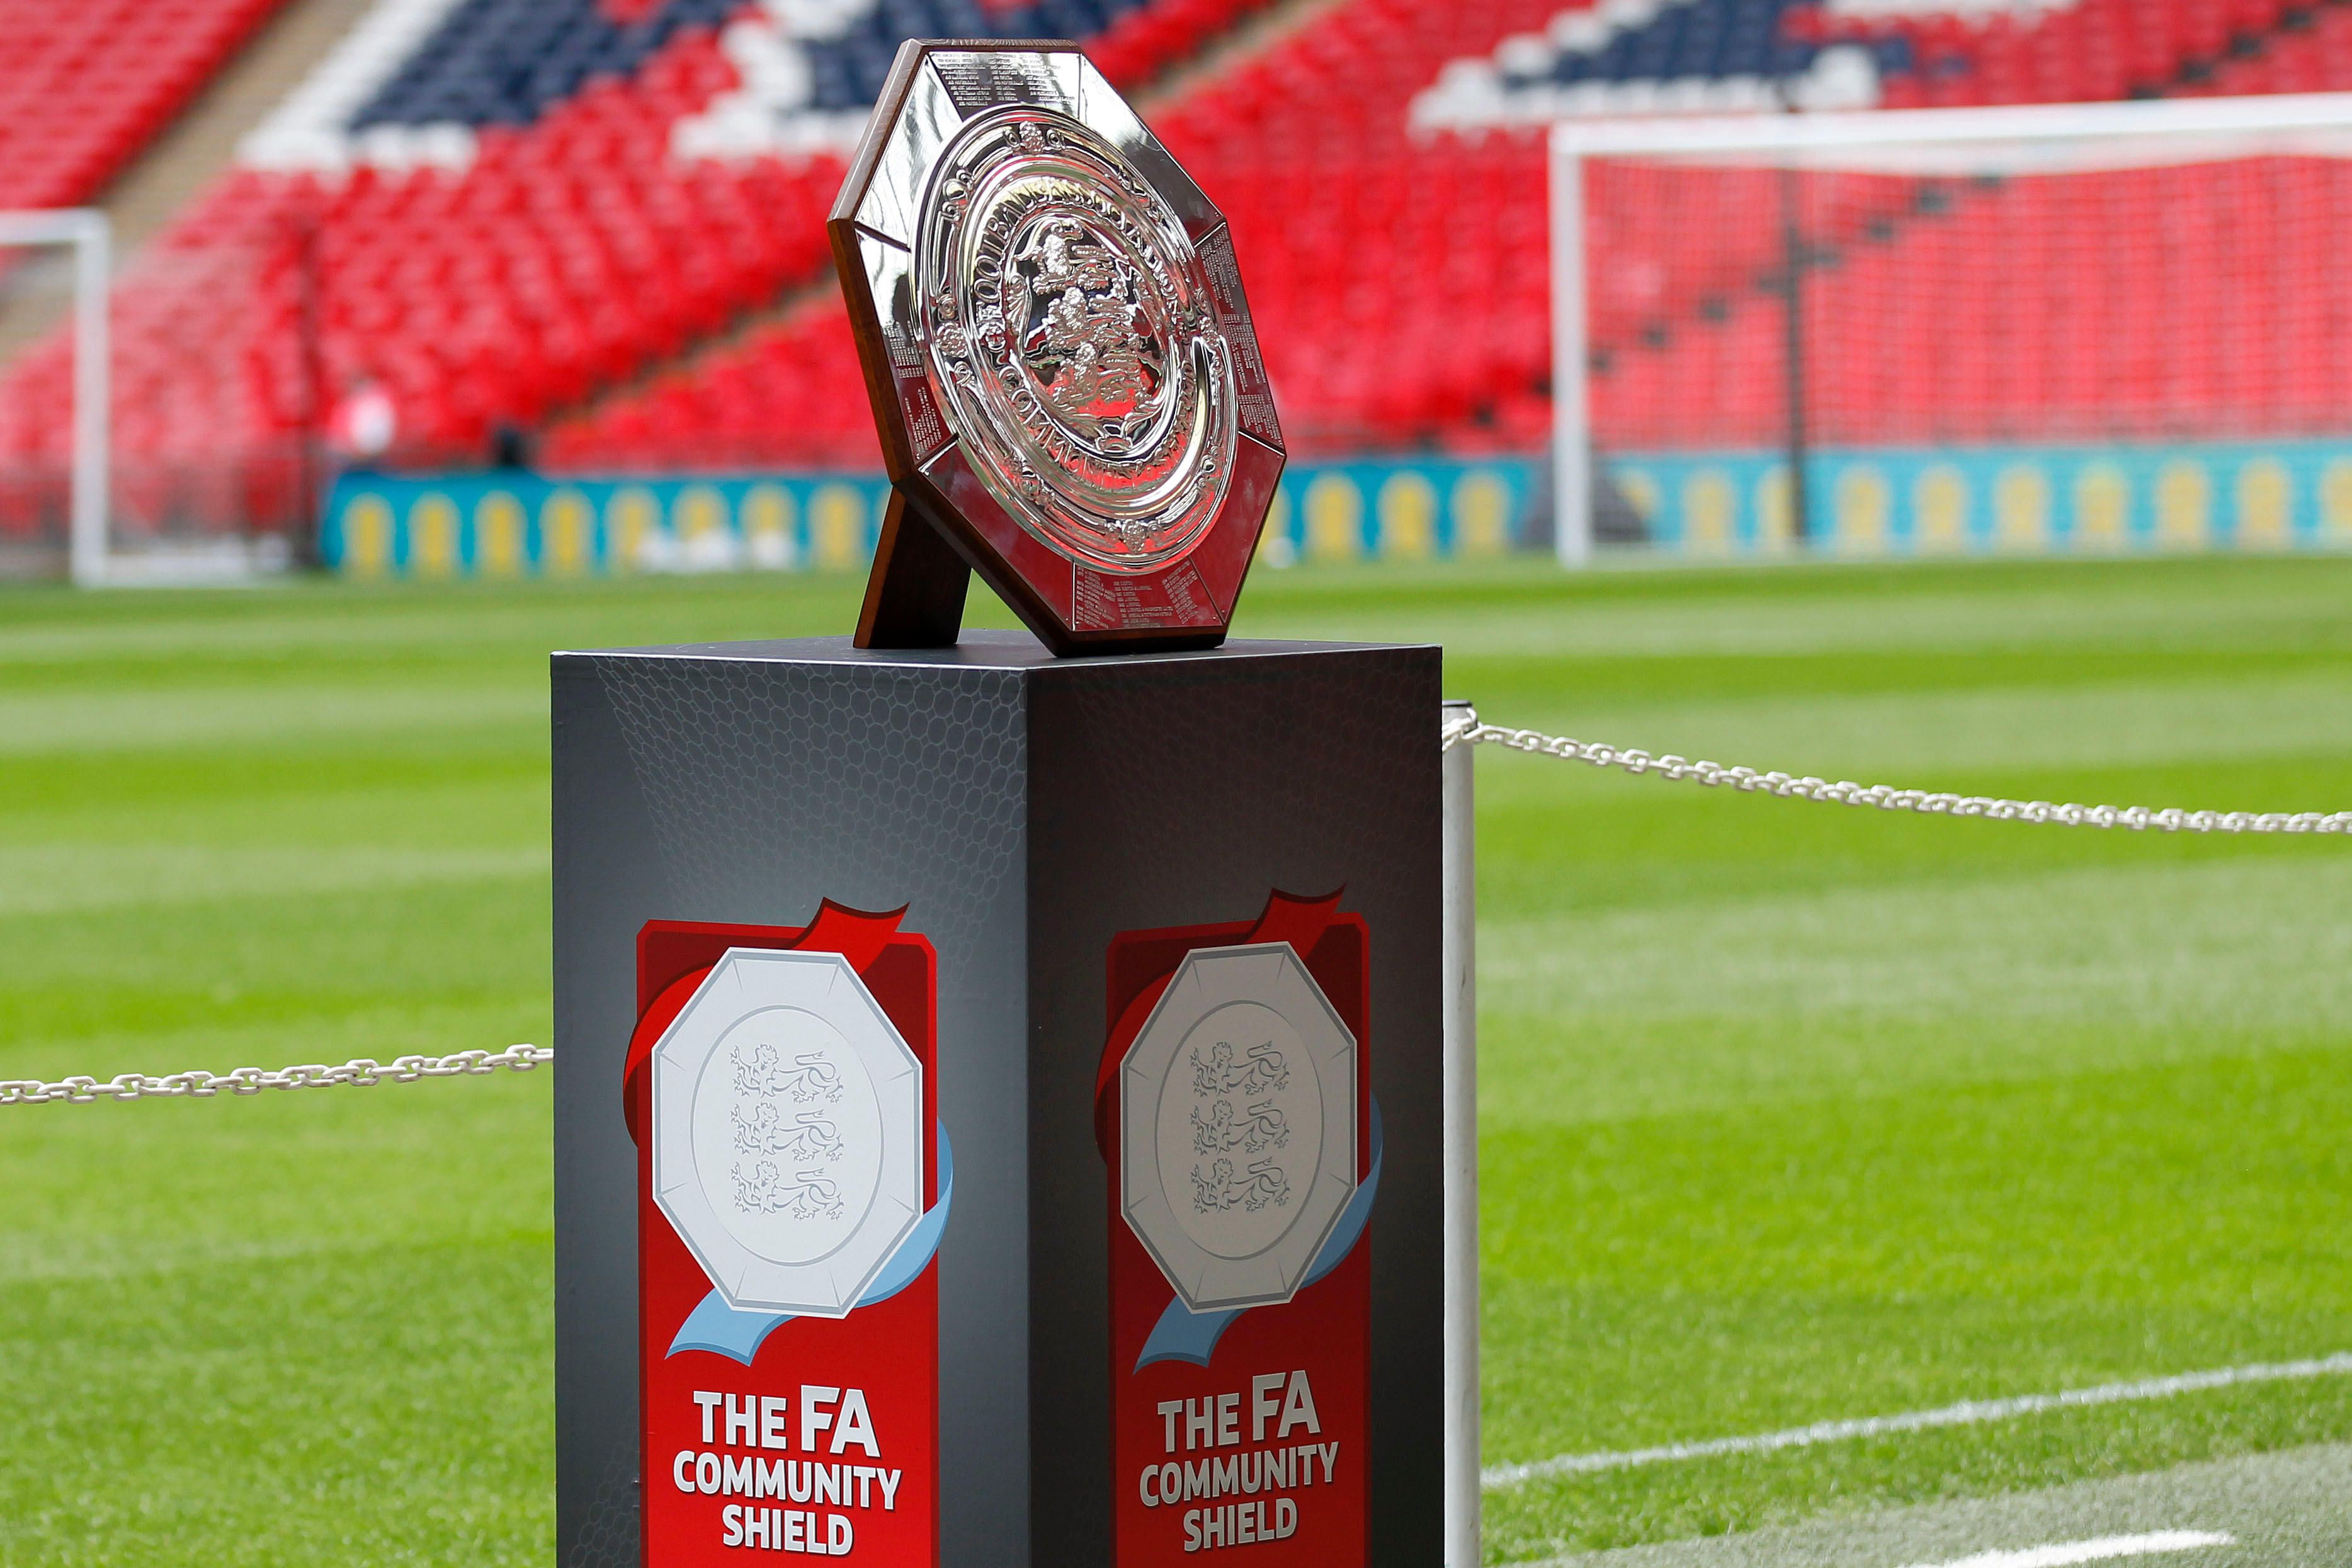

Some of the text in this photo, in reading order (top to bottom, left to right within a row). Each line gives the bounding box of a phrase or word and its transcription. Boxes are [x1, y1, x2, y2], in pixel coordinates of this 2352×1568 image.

[694, 1385, 880, 1457] THE FA
[1158, 1370, 1320, 1452] THE FA
[674, 1451, 901, 1509] COMMUNITY
[1140, 1441, 1338, 1506] COMMUNITY
[723, 1504, 852, 1555] SHIELD
[1184, 1498, 1297, 1551] SHIELD
